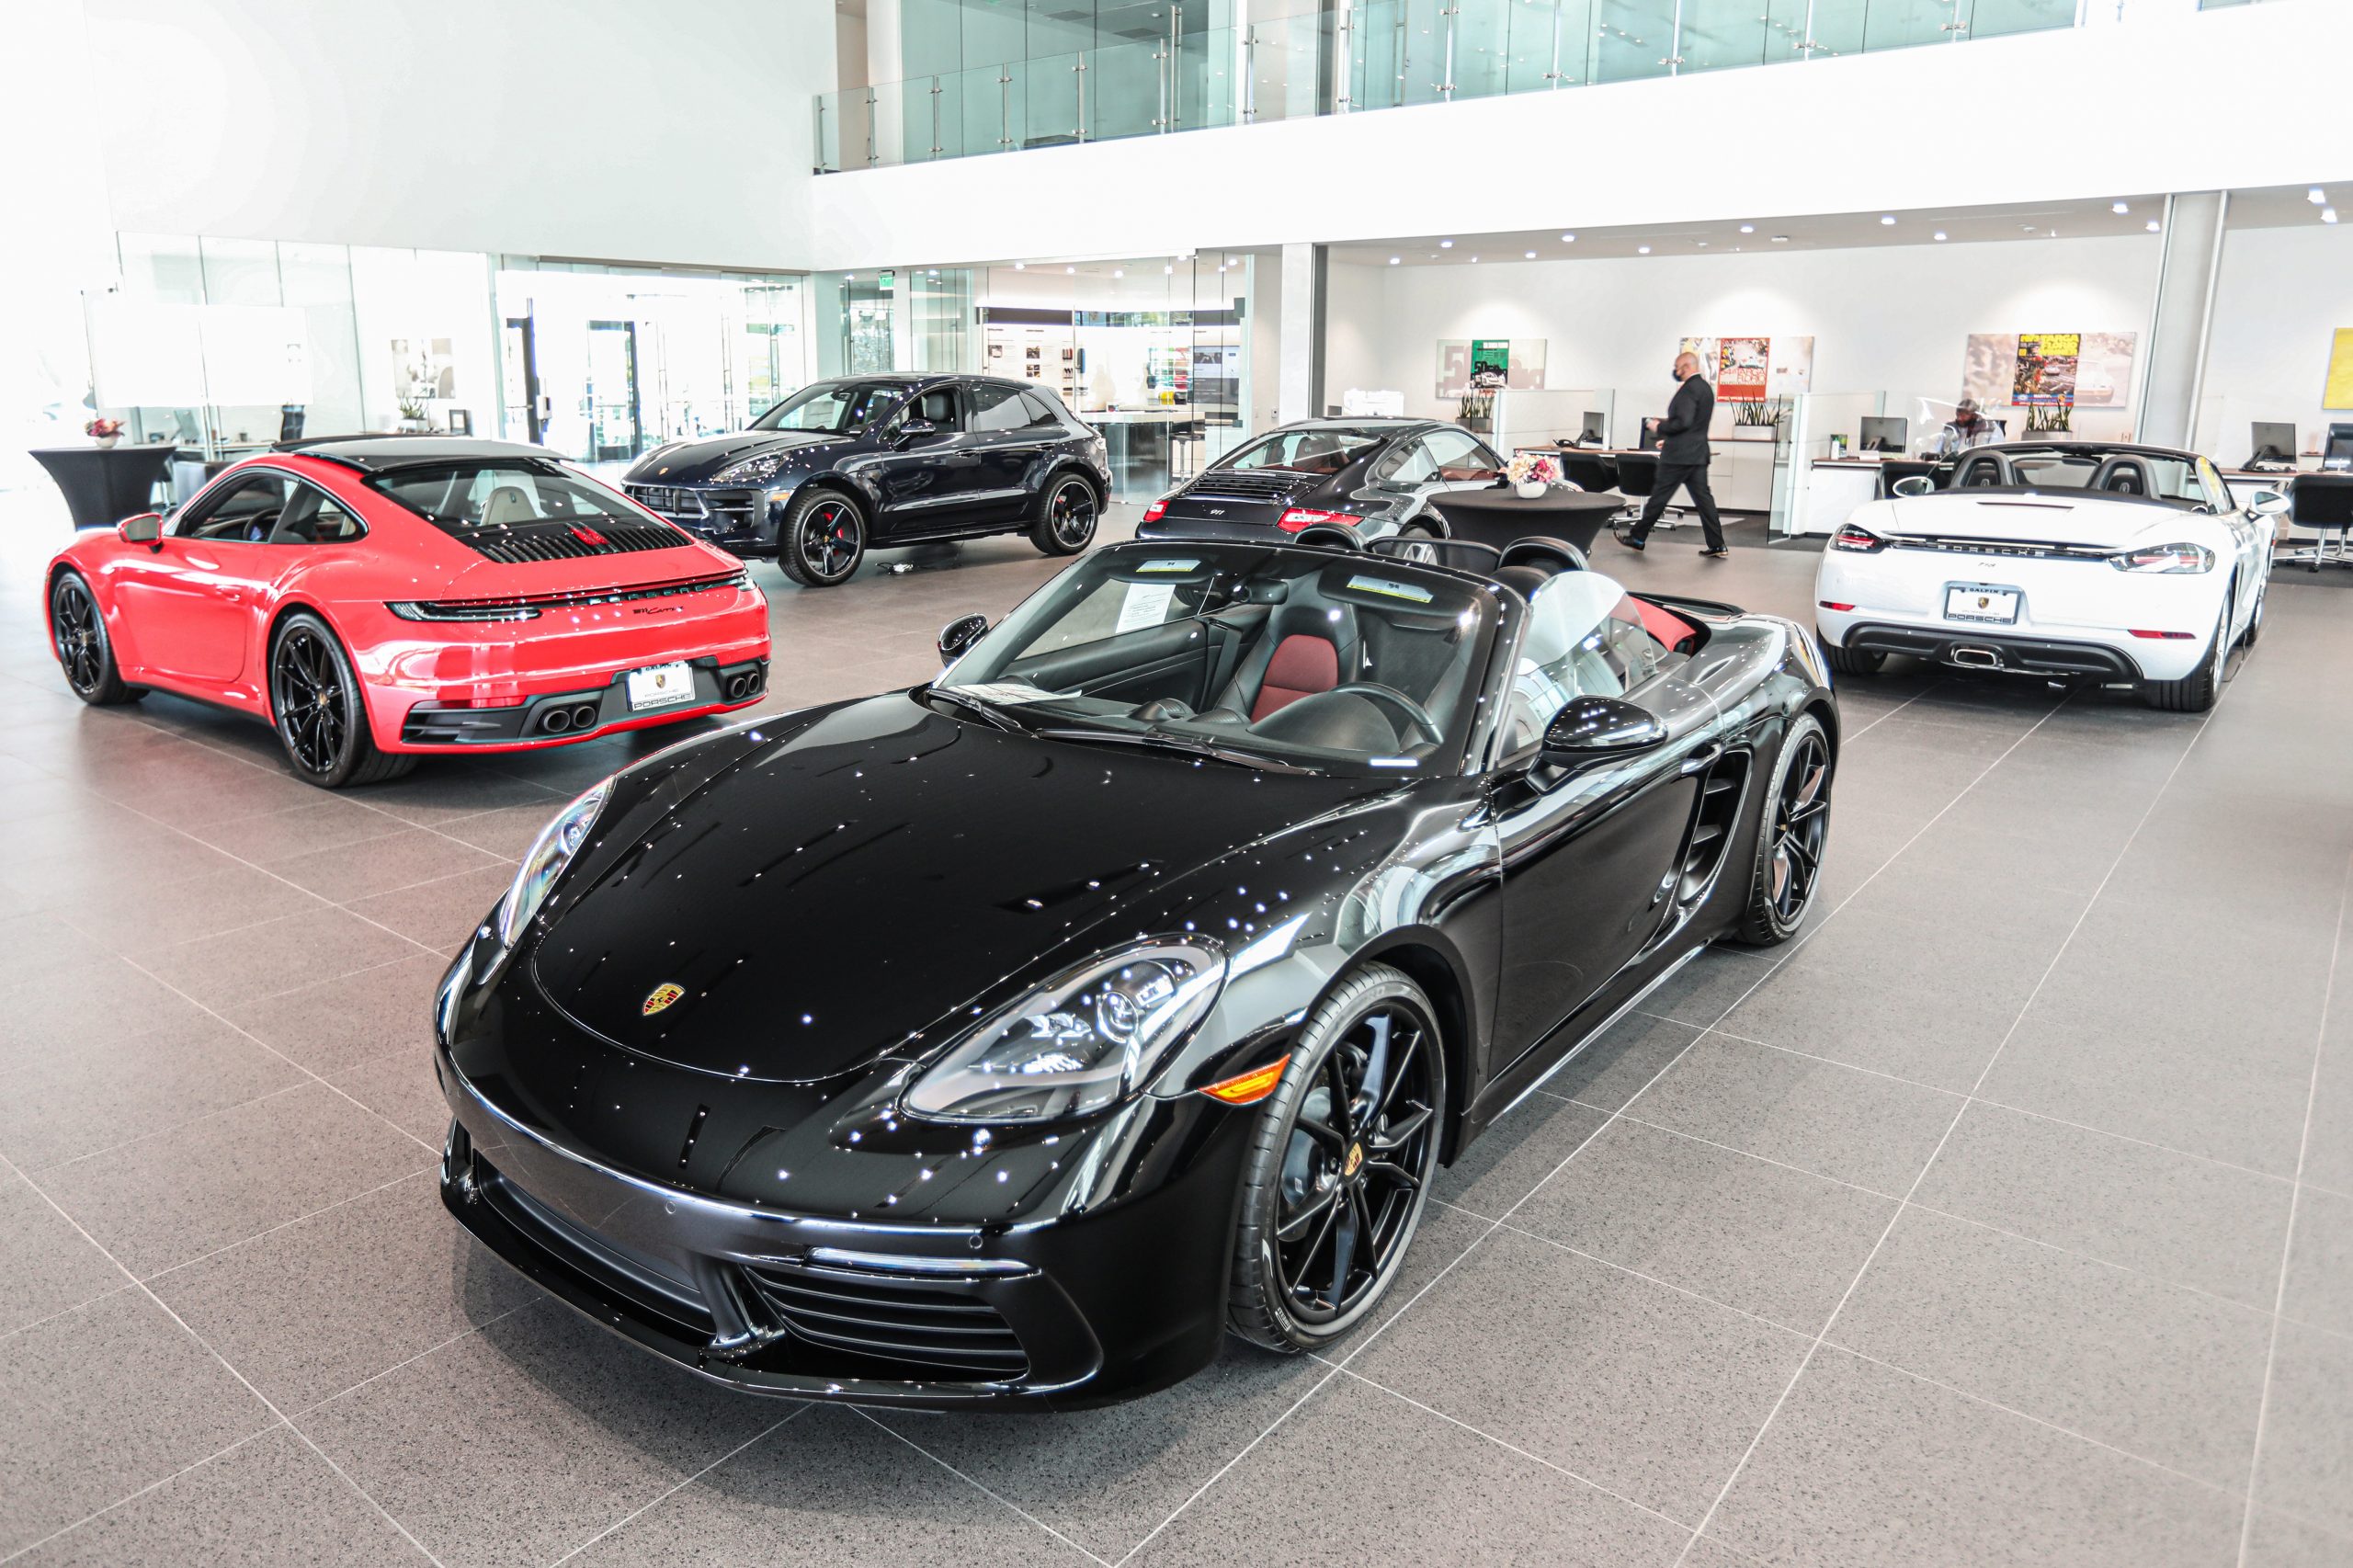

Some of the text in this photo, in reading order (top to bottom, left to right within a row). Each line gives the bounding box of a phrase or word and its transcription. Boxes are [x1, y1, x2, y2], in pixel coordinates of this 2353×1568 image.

[1938, 545, 2045, 557] PORSCHE
[1948, 613, 2012, 623] PORSCHE
[633, 693, 692, 710] PORSCHE
